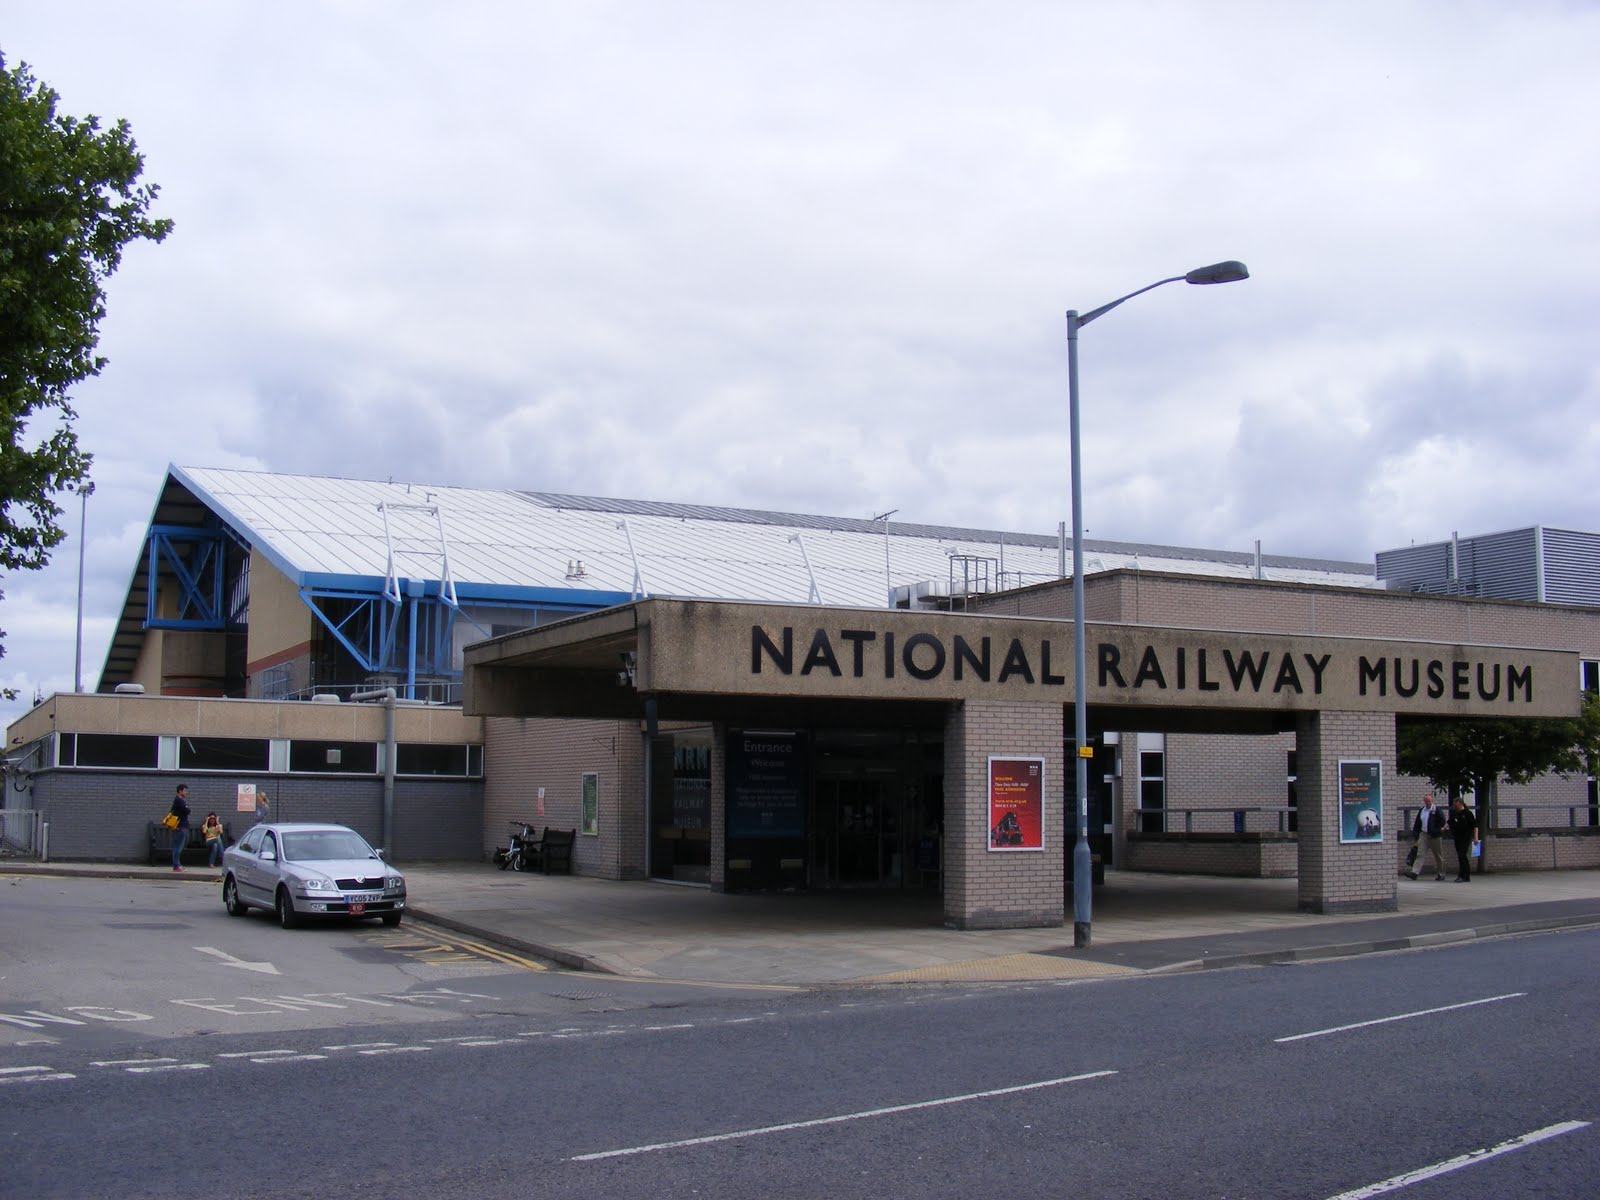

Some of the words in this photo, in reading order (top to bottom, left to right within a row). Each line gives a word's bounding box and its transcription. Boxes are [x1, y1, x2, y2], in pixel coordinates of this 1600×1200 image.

[752, 625, 1065, 686] NATIONAL
[1098, 643, 1332, 694] RAILWAY
[1359, 655, 1532, 702] MUSEUM
[743, 740, 793, 753] Entrance
[674, 744, 708, 770] NRM
[674, 799, 704, 809] RAILWAY
